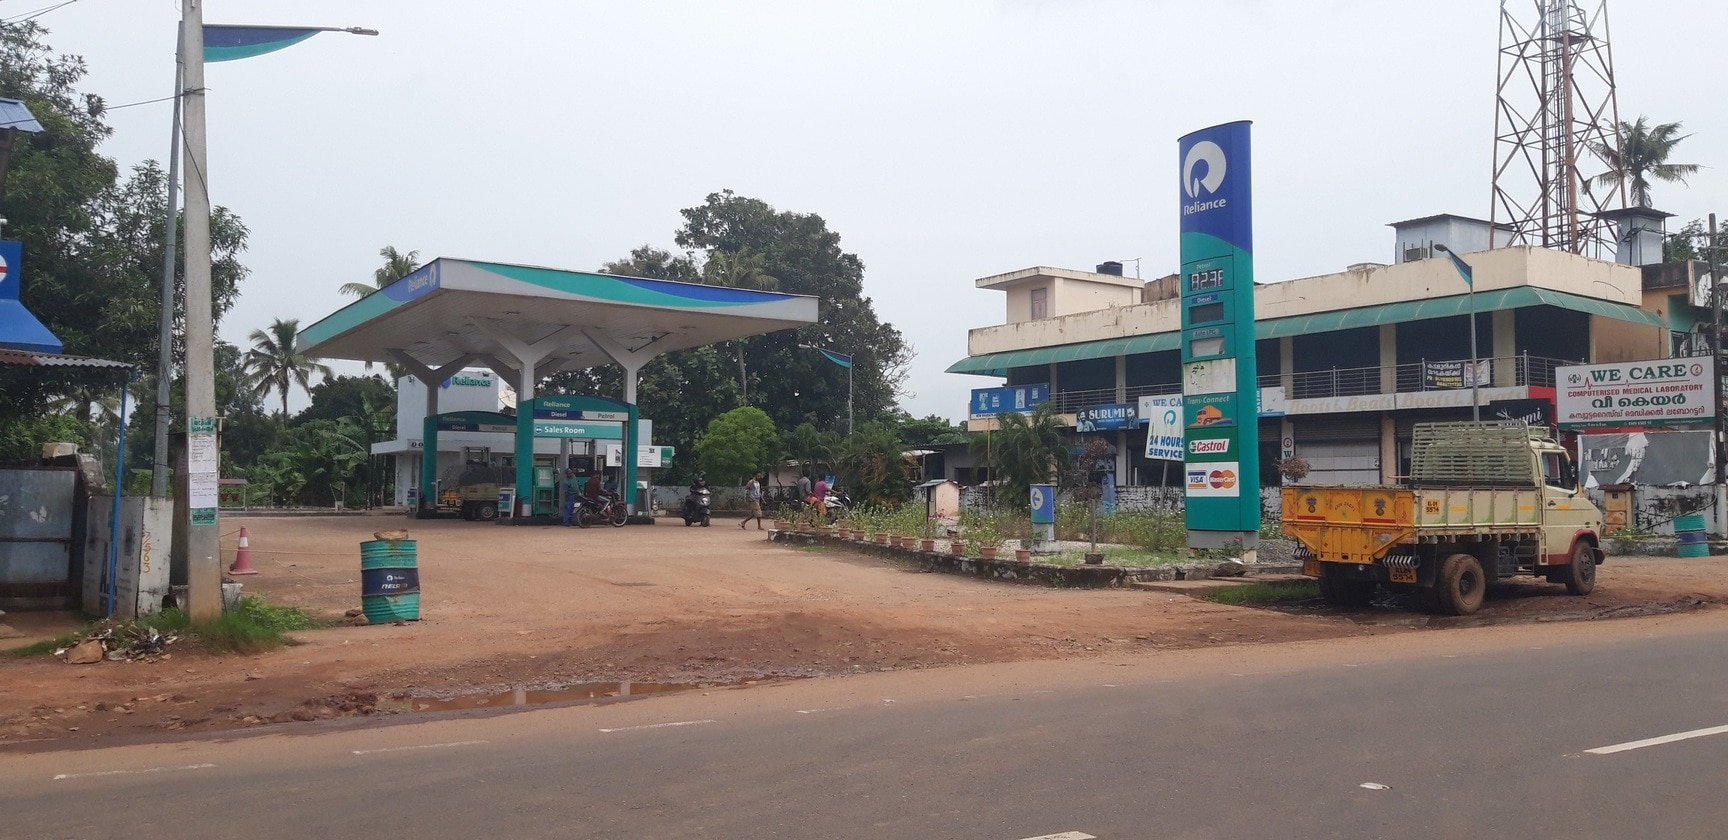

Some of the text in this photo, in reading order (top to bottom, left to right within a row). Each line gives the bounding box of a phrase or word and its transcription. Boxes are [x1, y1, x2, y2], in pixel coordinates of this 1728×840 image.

[1184, 199, 1226, 215] Reliance
[408, 275, 428, 293] Reliance
[1590, 364, 1687, 382] WE CARE
[452, 376, 491, 387] Reliance
[1567, 389, 1620, 397] COMPUTERISED
[1656, 384, 1703, 393] LABORATORY
[1170, 398, 1183, 406] CA
[1591, 393, 1686, 408] വീ കെയർ
[1088, 408, 1125, 419] SURUMI
[544, 426, 585, 434] Sales Room
[1149, 435, 1159, 445] 24
[1196, 440, 1226, 452] Castrol
[1148, 448, 1183, 458] SERVICE
[1190, 476, 1204, 484] VISA
